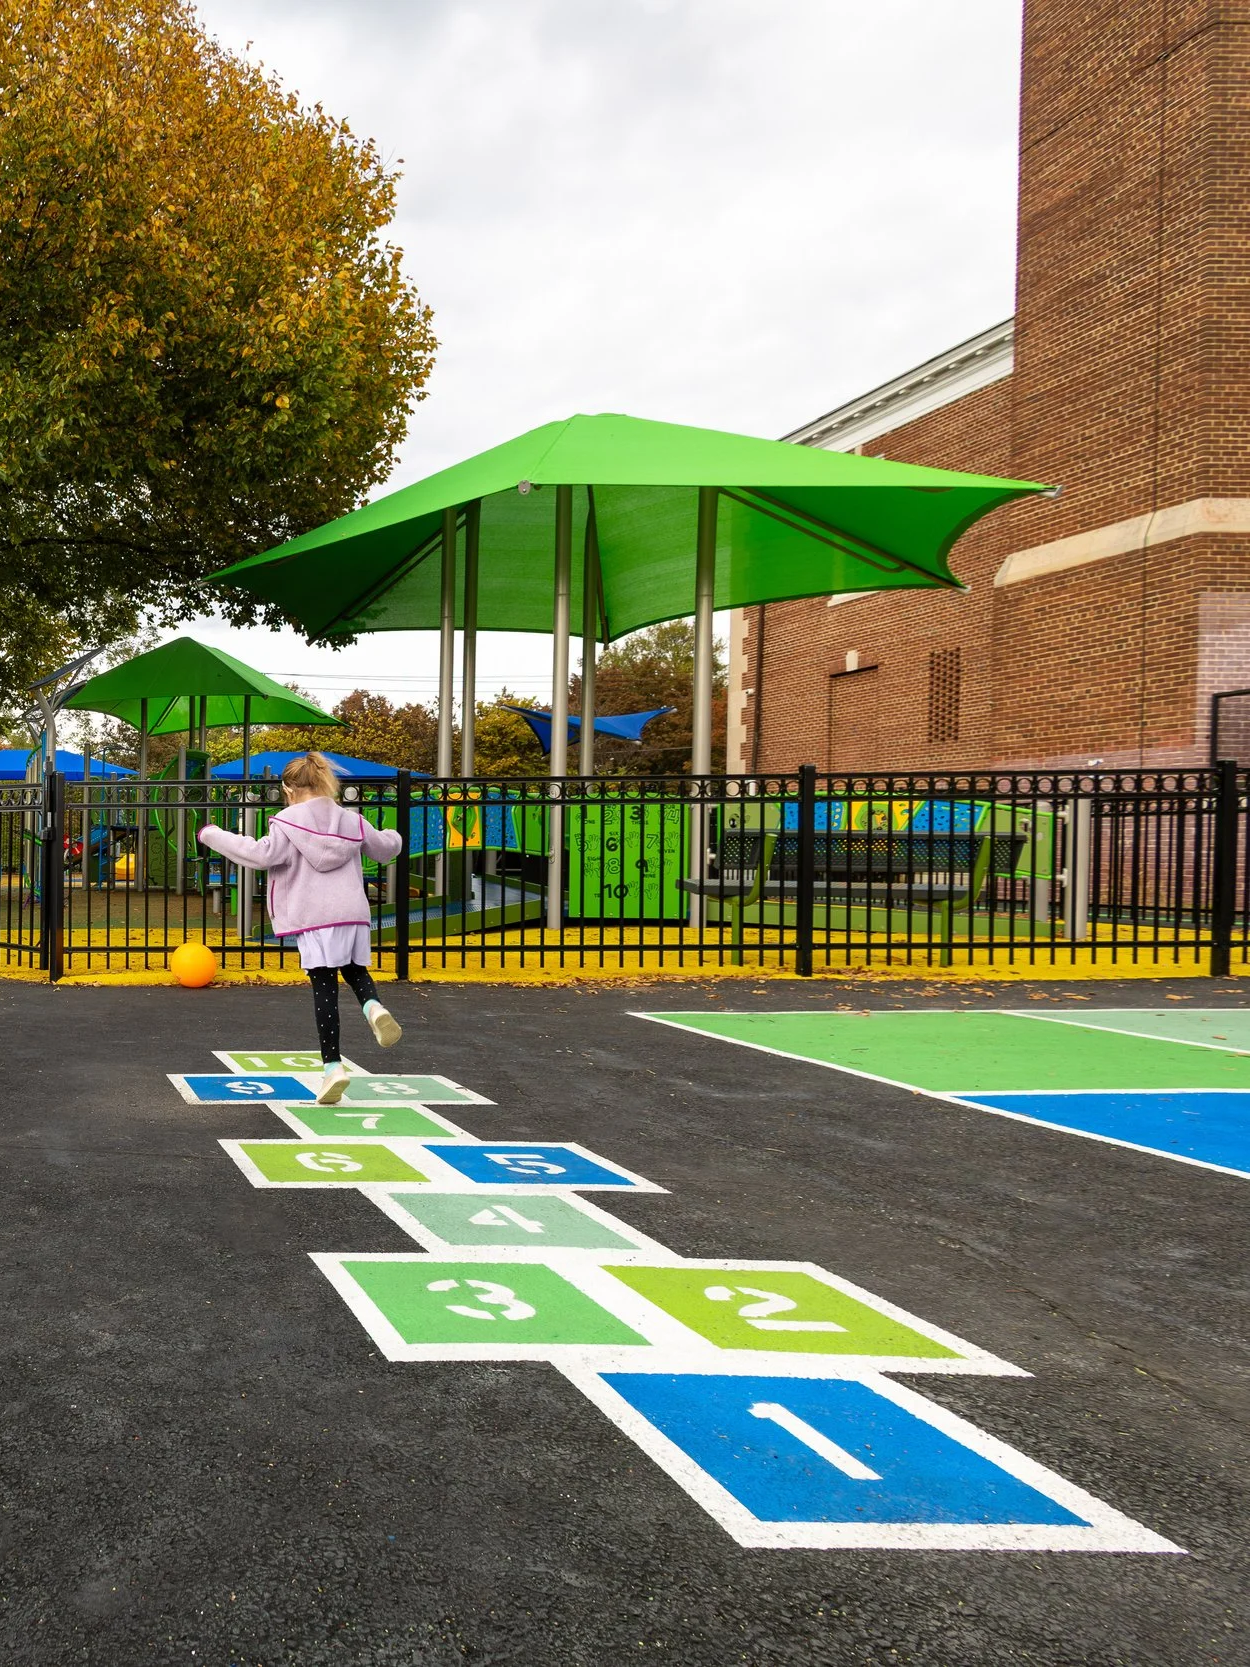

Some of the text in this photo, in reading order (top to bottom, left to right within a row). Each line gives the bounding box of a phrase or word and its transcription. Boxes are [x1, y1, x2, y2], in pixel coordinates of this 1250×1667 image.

[603, 809, 614, 825] 2
[630, 805, 642, 820] 3
[666, 809, 680, 824] 4
[605, 837, 619, 852] 6
[646, 833, 659, 849] 7
[607, 857, 621, 874] 8
[635, 859, 649, 872] 9
[603, 883, 629, 899] 10
[245, 1056, 324, 1068] 10
[225, 1081, 275, 1095] 9
[367, 1081, 420, 1096] 8
[333, 1113, 386, 1130] 7
[294, 1151, 363, 1173] 6
[482, 1153, 567, 1175] 5
[468, 1205, 546, 1233] 4
[425, 1278, 537, 1321] 3
[703, 1285, 849, 1333] 2
[748, 1402, 884, 1481] 1
